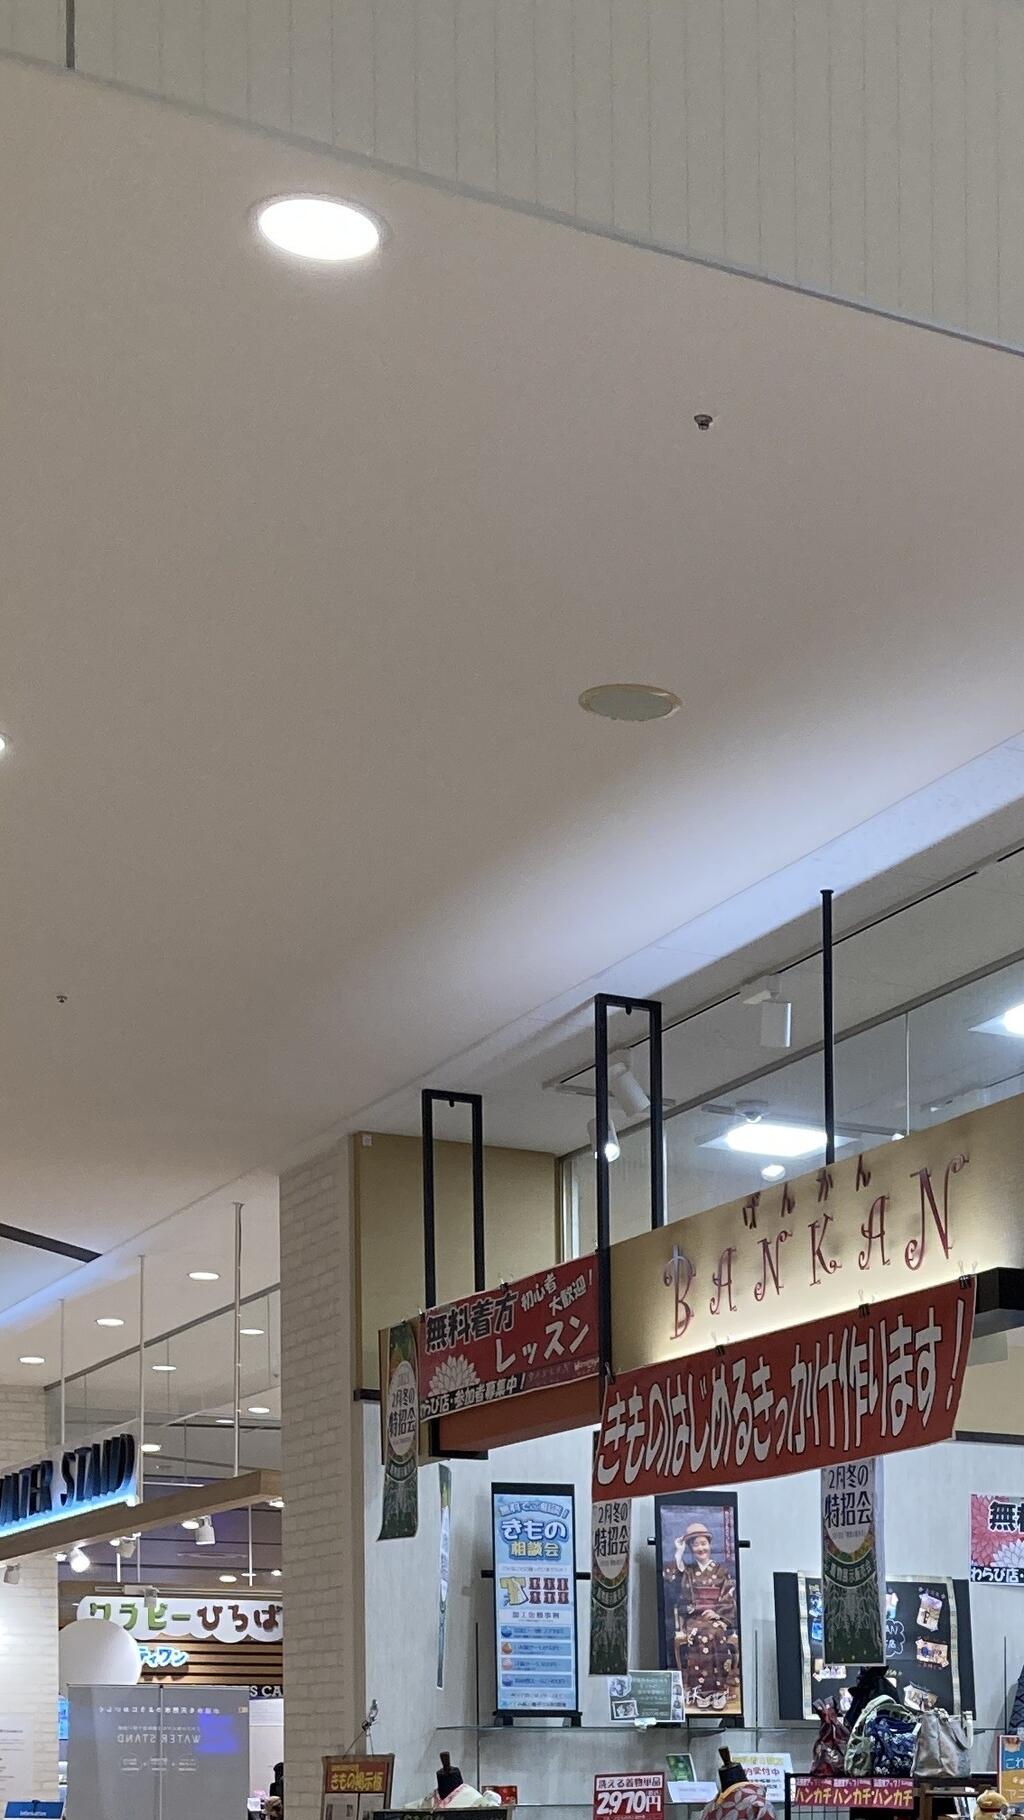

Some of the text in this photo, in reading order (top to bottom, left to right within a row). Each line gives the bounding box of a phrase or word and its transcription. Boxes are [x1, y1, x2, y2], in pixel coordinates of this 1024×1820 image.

[663, 1152, 971, 1341] BANKAN
[521, 1271, 559, 1312] 初心者
[548, 1268, 594, 1317] 大歓迎！
[426, 1290, 520, 1354] 無料着方
[495, 1315, 590, 1374] レッスン
[597, 1298, 966, 1487] きものはじめるきっかけ作ります！
[60, 1433, 135, 1506] STAND
[828, 1464, 869, 1490] 2月冬の
[598, 1503, 628, 1523] 2月冬の
[824, 1491, 872, 1529] 特招会
[501, 1518, 568, 1541] きもの
[594, 1525, 629, 1558] 特招会
[511, 1541, 560, 1557] 相談会
[90, 1602, 282, 1634] ワラビーひろば
[598, 1776, 661, 1789] 洗える着物単品
[796, 1787, 913, 1806] ハンカチ ハンカチ ハンカチ
[596, 1790, 662, 1816] 2,970円
